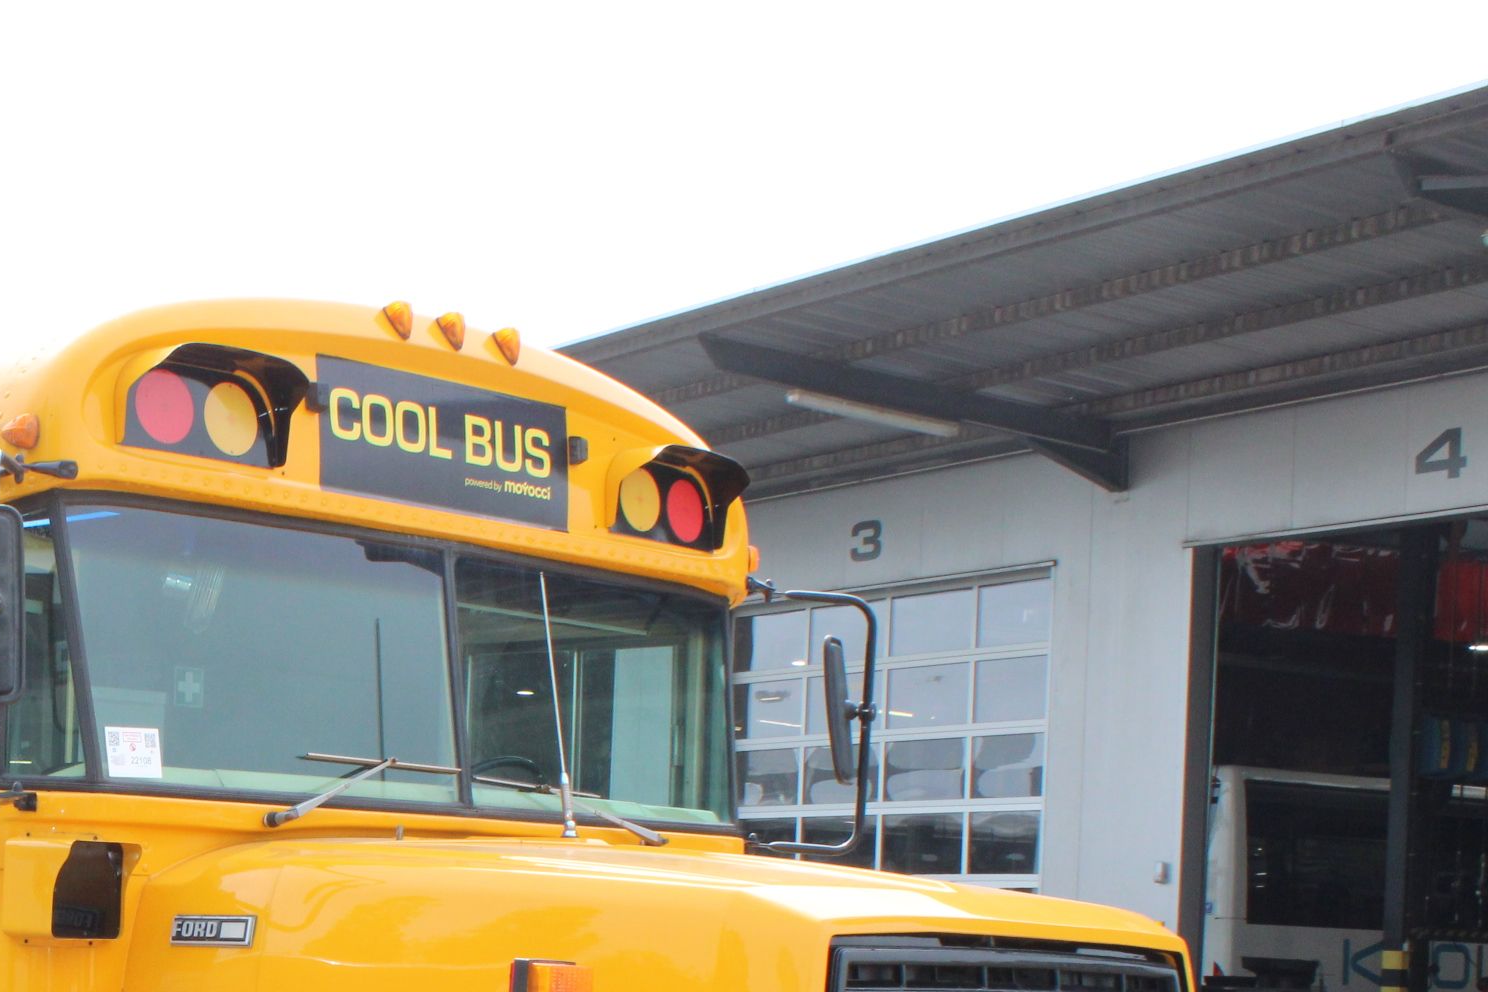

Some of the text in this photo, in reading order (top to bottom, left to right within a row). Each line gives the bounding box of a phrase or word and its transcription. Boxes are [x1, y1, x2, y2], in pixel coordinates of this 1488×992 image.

[329, 387, 551, 479] COOL BUS
[1415, 427, 1468, 479] 4
[464, 477, 493, 490] powered
[493, 480, 503, 493] by
[850, 520, 882, 562] 3
[173, 919, 218, 938] FORD
